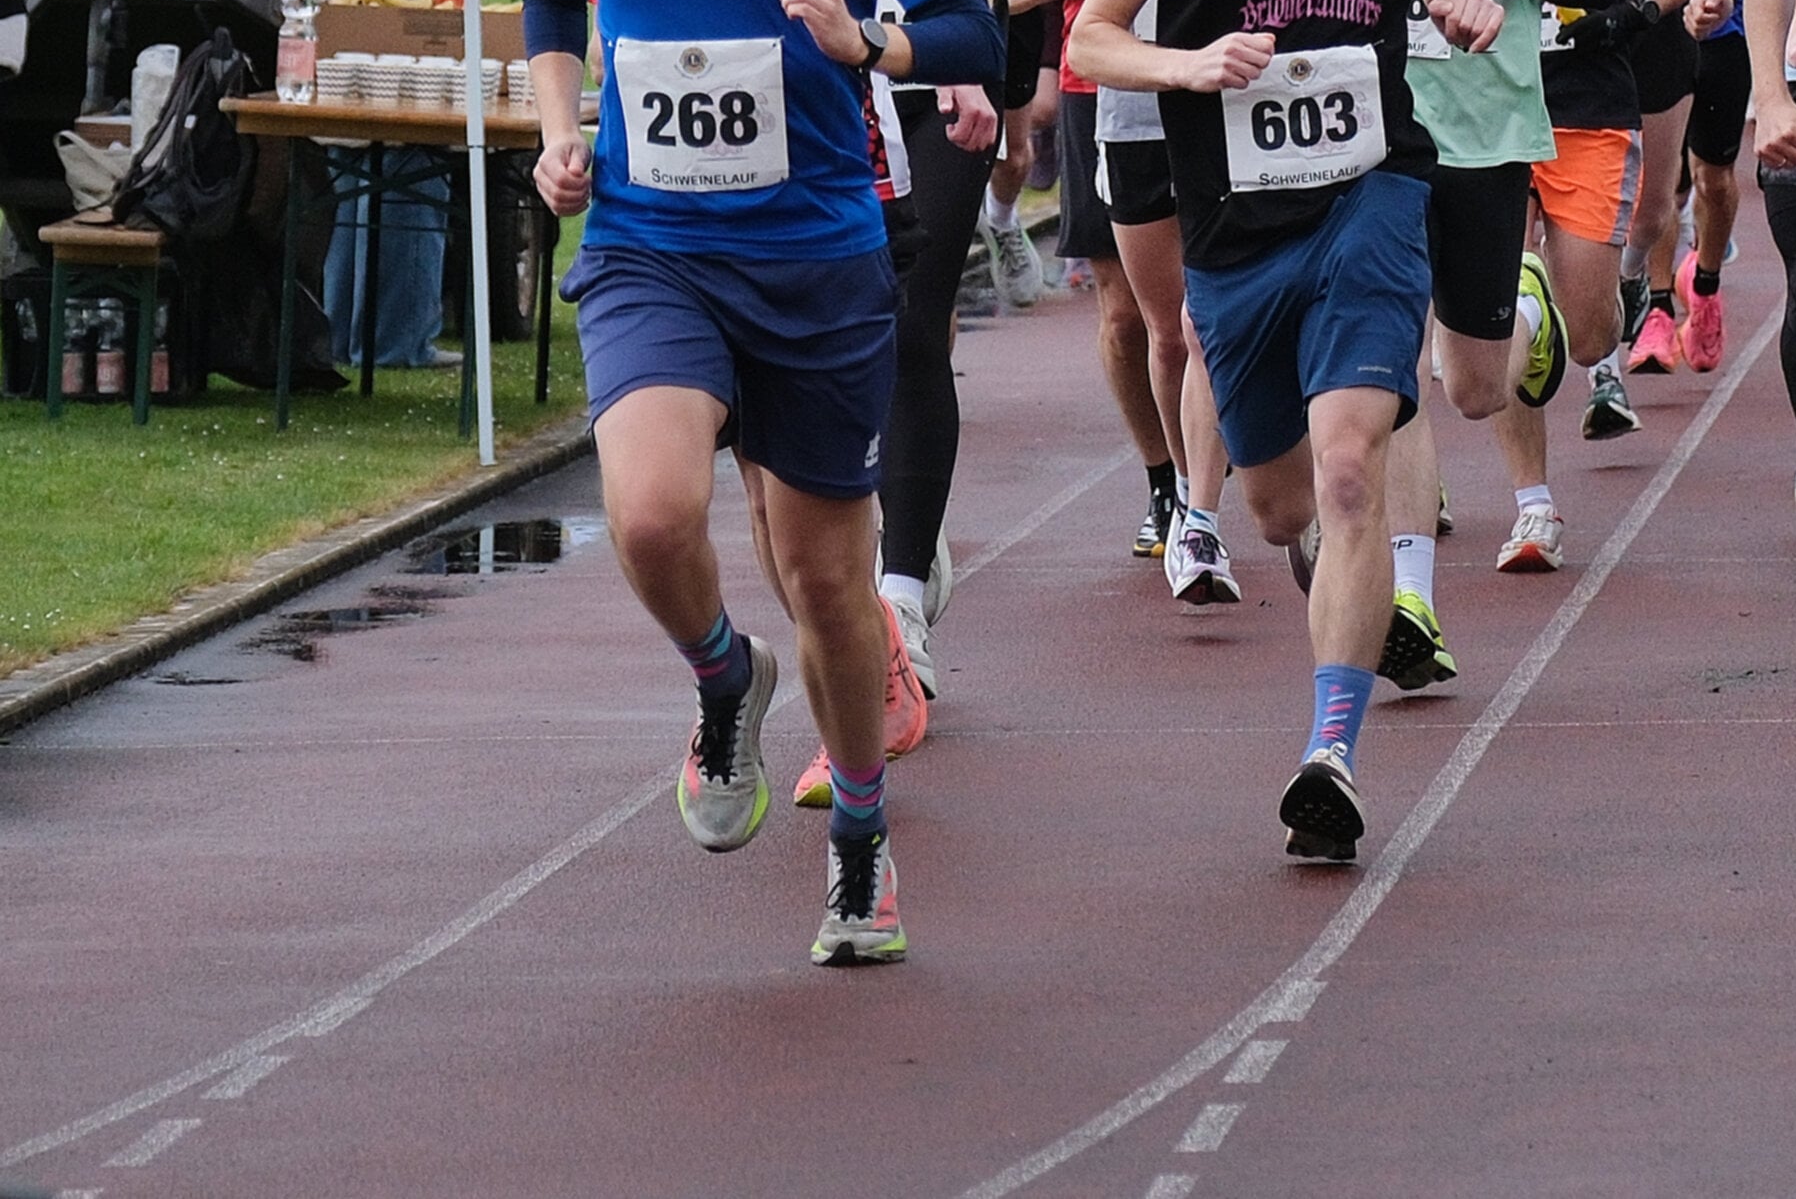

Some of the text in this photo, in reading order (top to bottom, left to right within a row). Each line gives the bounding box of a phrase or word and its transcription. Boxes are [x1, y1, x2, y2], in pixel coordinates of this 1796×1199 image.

[642, 90, 758, 148] 268
[1251, 91, 1358, 151] 603
[651, 168, 759, 185] SCHWEINELAUF
[1258, 164, 1362, 186] SCHWEINELAUF
